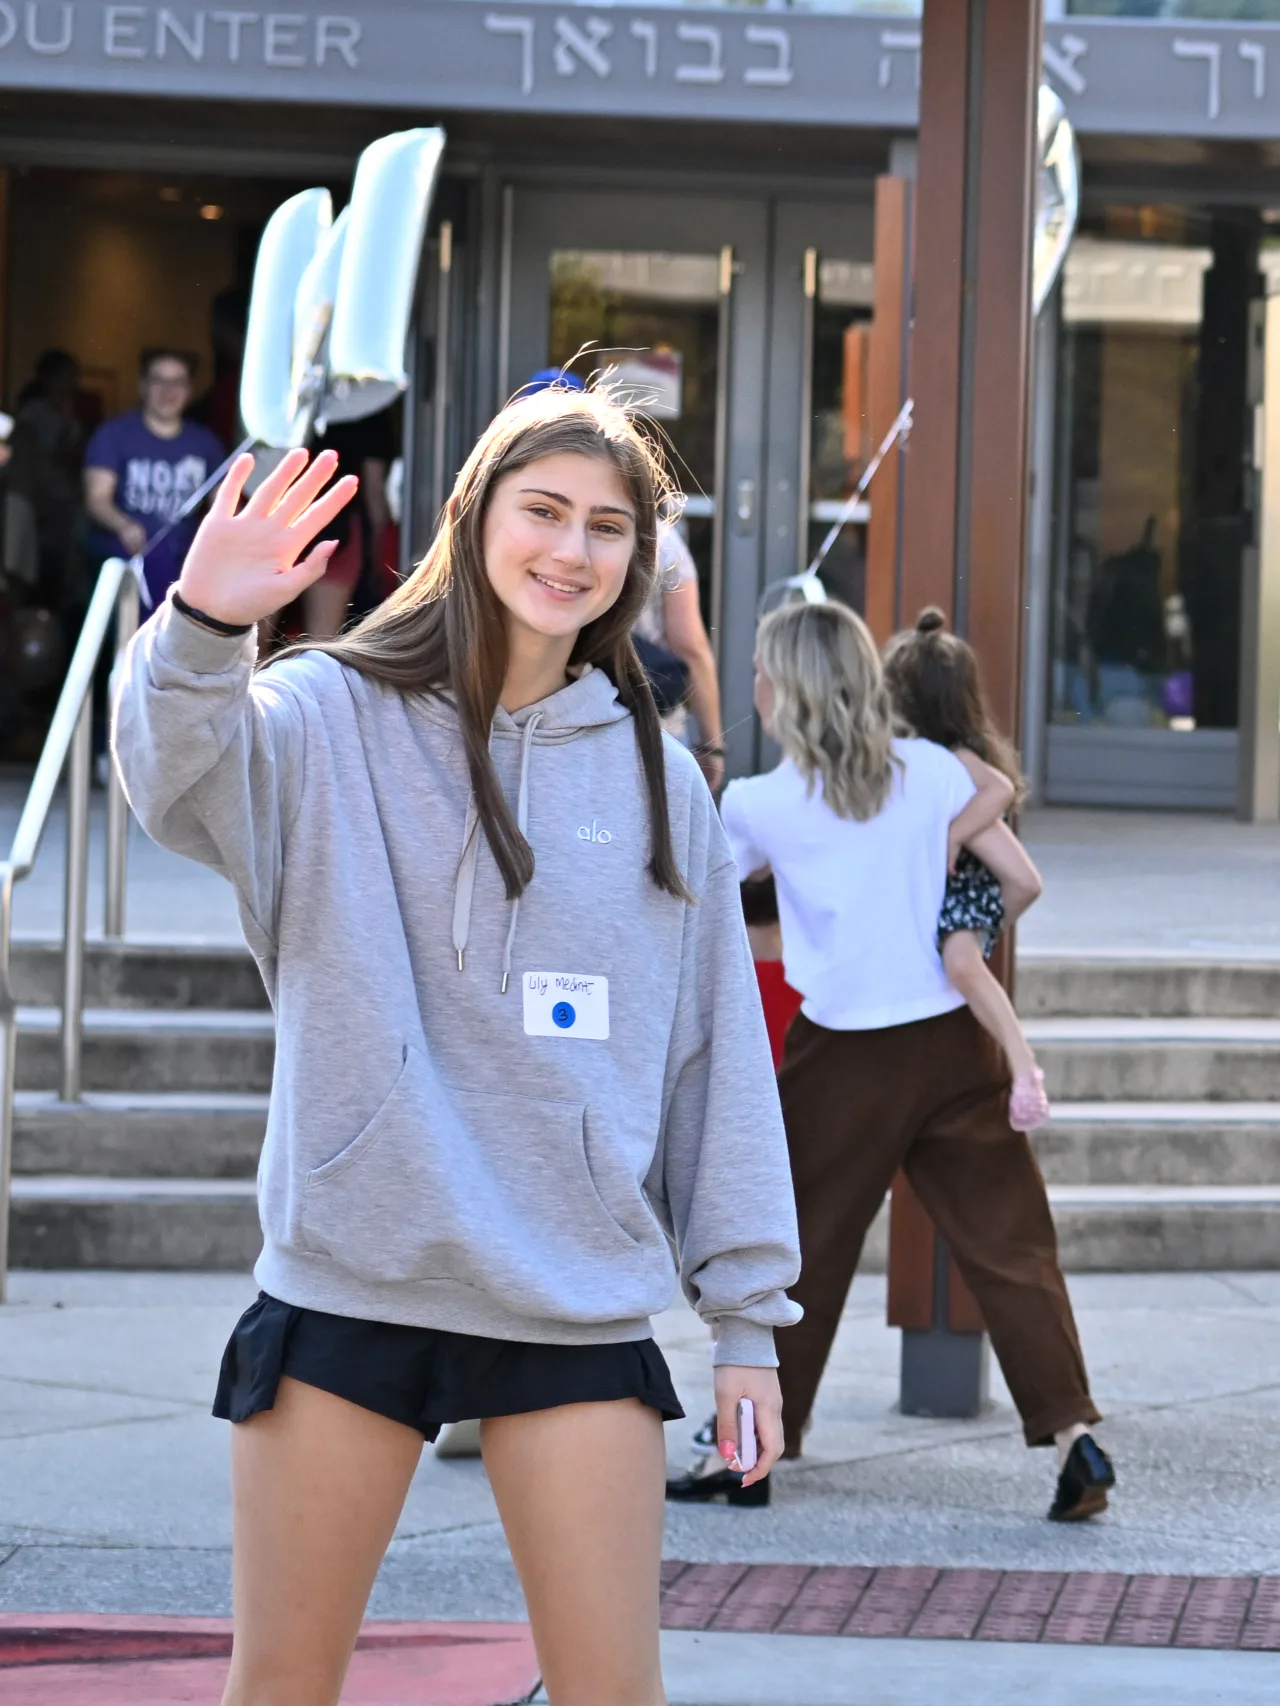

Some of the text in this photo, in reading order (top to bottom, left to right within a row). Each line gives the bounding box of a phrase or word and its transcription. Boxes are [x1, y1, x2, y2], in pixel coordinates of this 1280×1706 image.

[103, 4, 363, 68] ENTER
[484, 13, 794, 96] בבואך
[576, 820, 612, 844] alo
[558, 1008, 569, 1022] 3
